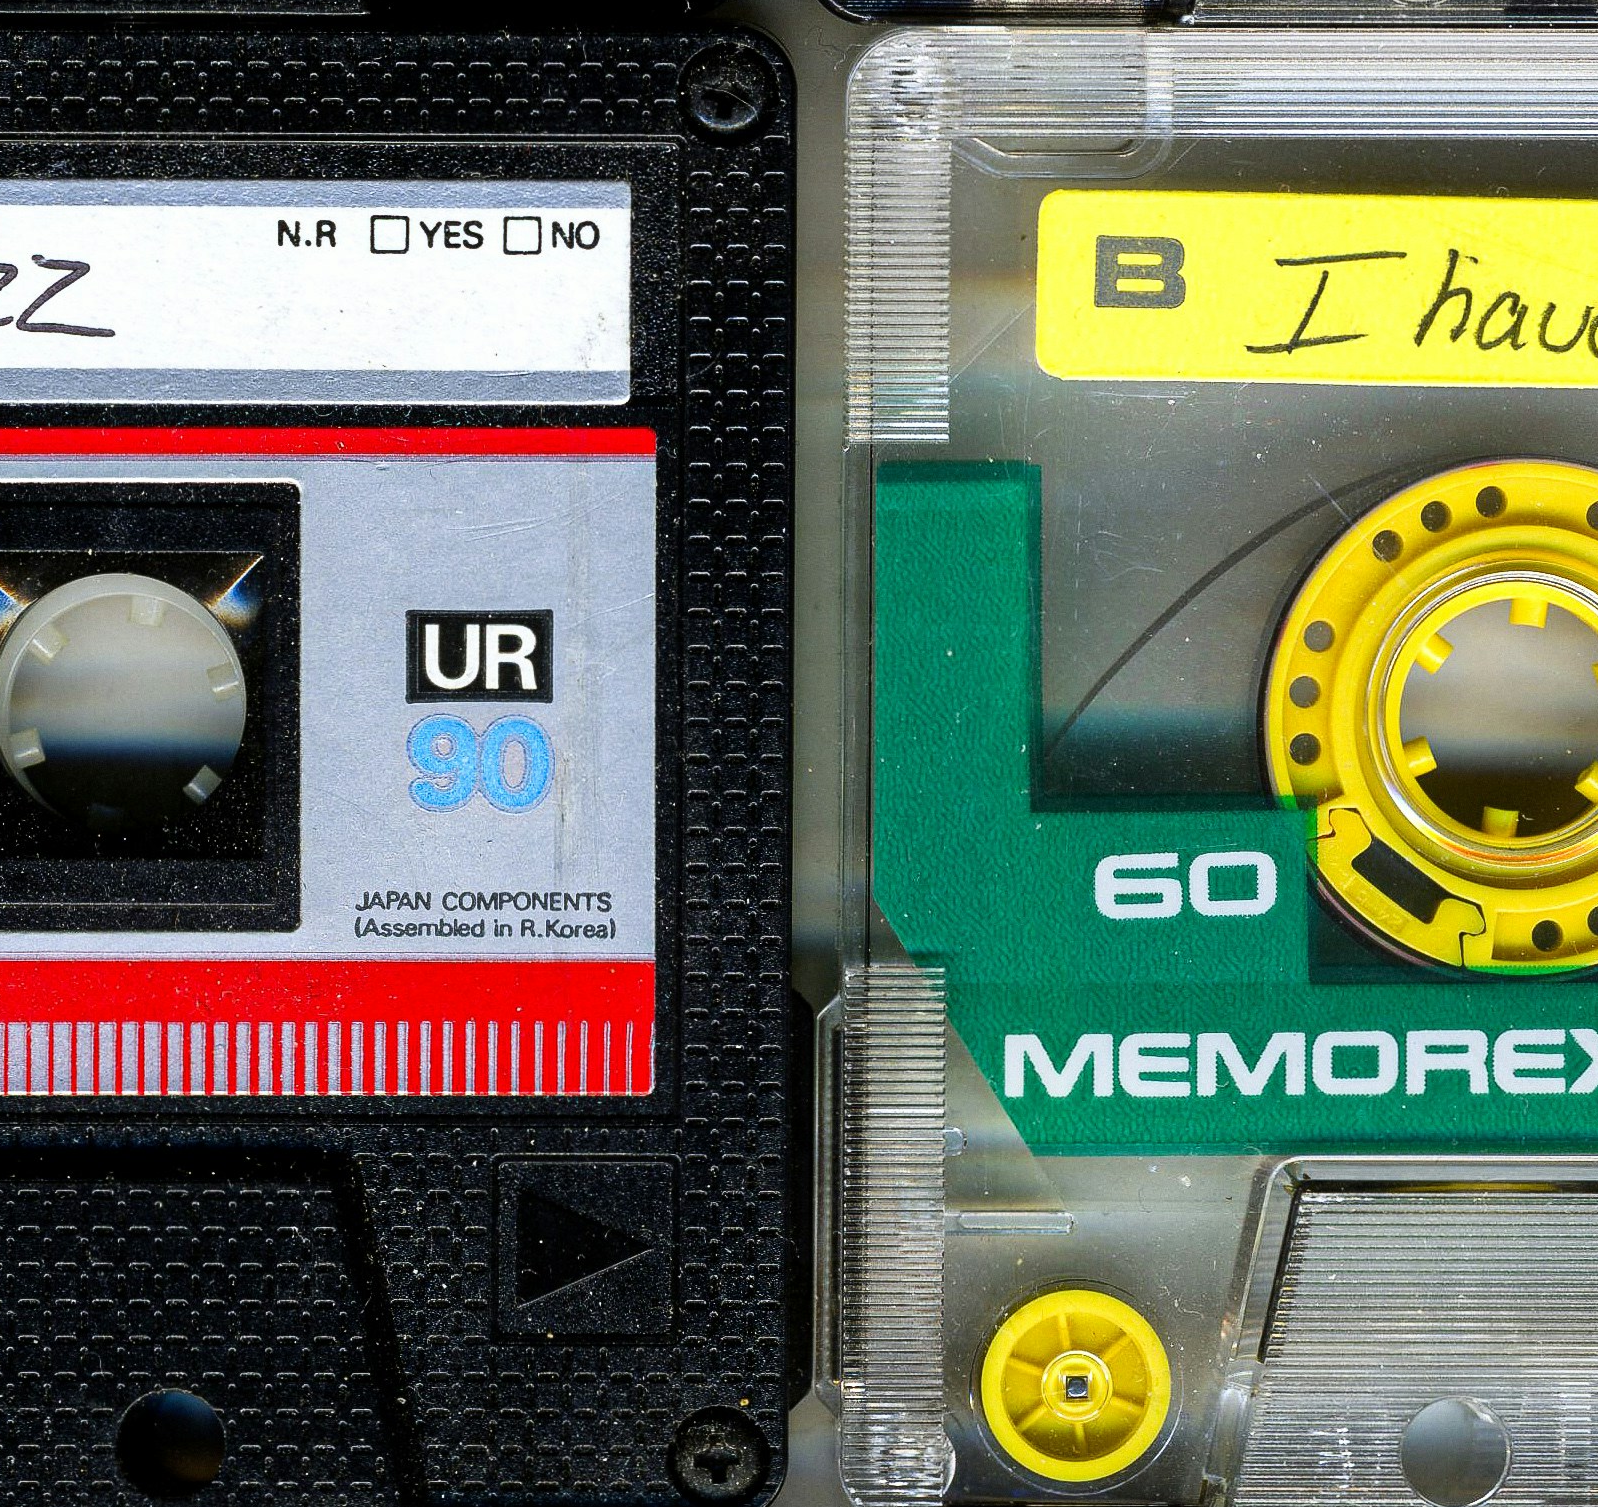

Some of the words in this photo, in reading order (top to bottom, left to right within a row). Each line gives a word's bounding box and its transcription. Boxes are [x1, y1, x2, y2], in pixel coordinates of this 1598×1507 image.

[277, 219, 337, 247] N.R
[420, 220, 484, 249] YES
[552, 220, 600, 249] NO
[1094, 235, 1186, 309] B
[1245, 251, 1407, 355] I
[425, 624, 538, 690] UR
[407, 713, 555, 814] 90
[355, 891, 432, 911] JAPAN
[442, 892, 612, 912] COMPONENTS
[1093, 851, 1278, 921] 60
[354, 916, 485, 938] (Assembled
[494, 919, 512, 937] in
